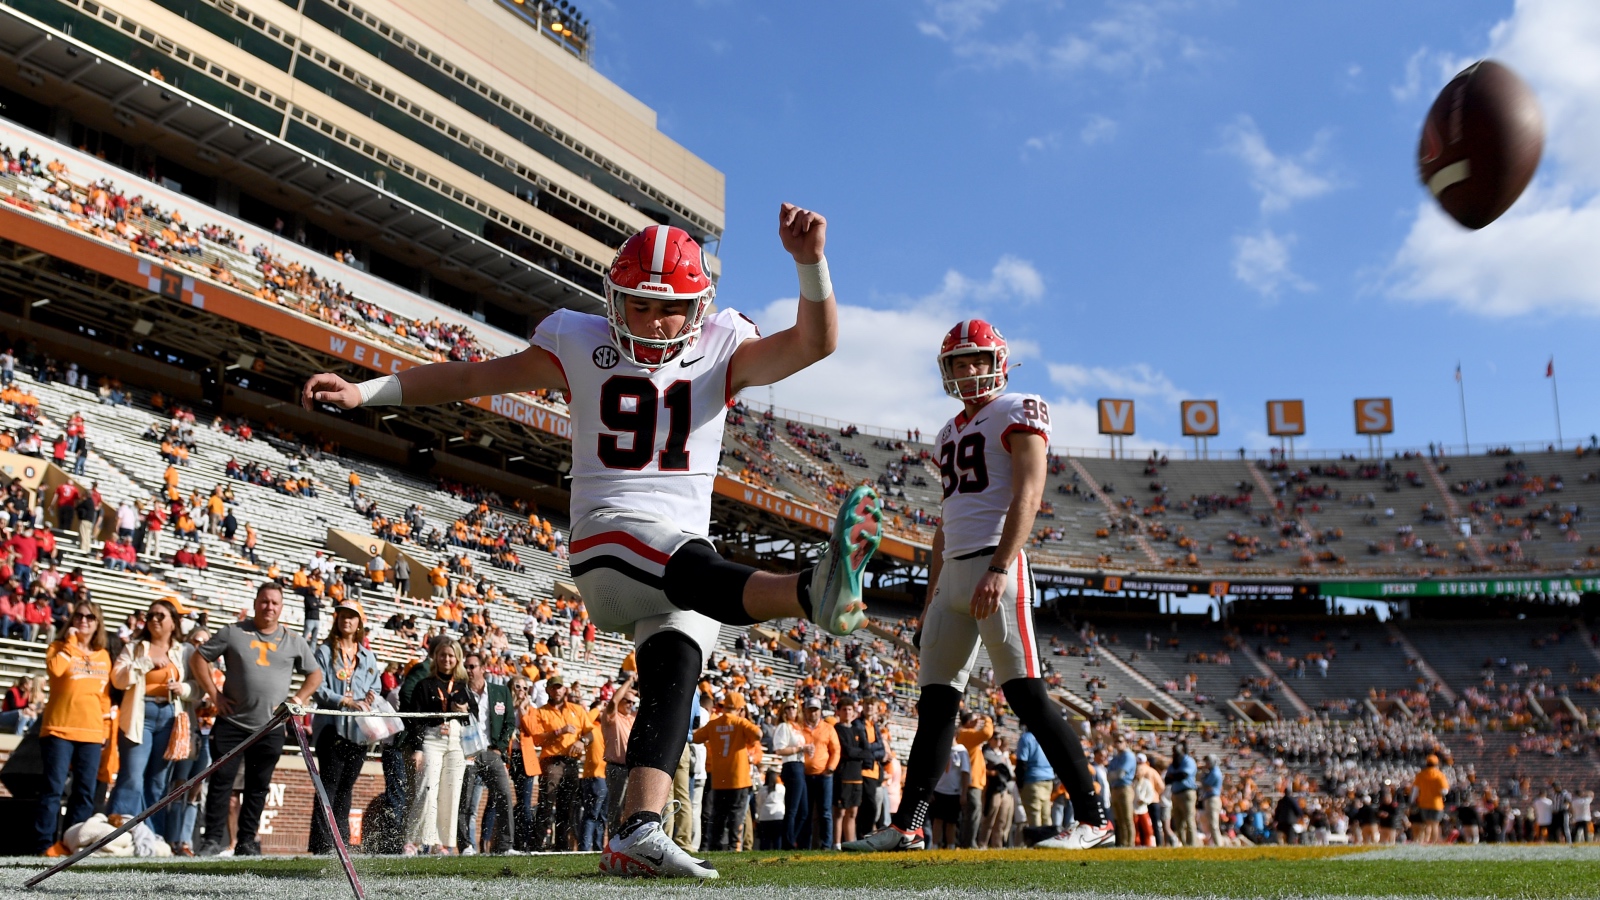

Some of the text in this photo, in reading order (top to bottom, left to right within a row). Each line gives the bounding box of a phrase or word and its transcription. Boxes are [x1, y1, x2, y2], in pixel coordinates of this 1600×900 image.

[641, 284, 668, 292] DAWGS
[595, 346, 618, 368] SEC
[490, 394, 546, 430] ROCKY
[597, 375, 692, 471] 91
[1023, 399, 1050, 426] 99
[744, 489, 812, 524] WELCOME
[1123, 580, 1152, 590] WILLIS
[1152, 581, 1188, 592] TUCKER
[1440, 581, 1487, 594] EVERY
[1496, 581, 1542, 594] DRIVE
[250, 639, 277, 667] T
[720, 734, 730, 757] 7
